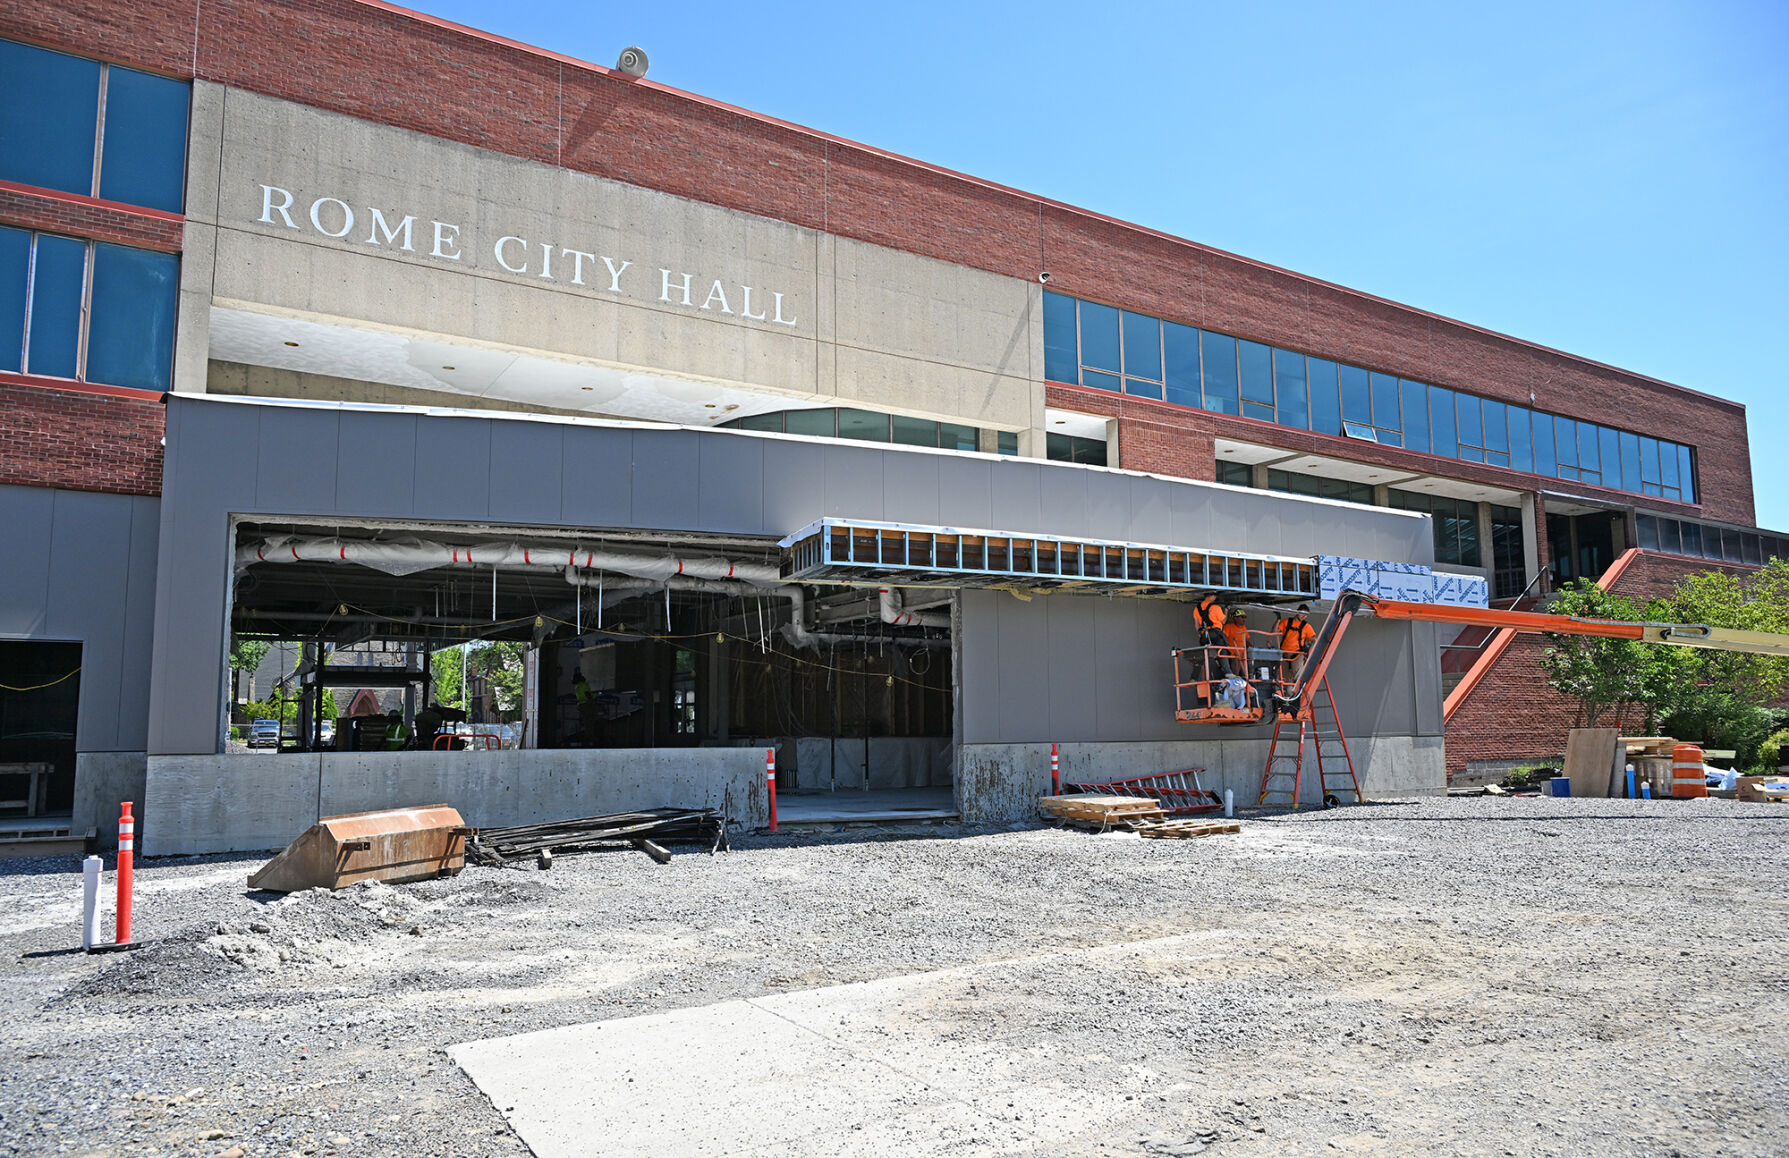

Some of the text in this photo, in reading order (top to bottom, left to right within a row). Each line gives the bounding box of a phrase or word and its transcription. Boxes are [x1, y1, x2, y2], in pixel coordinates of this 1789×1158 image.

[258, 184, 797, 327] ROME CITY HALL
